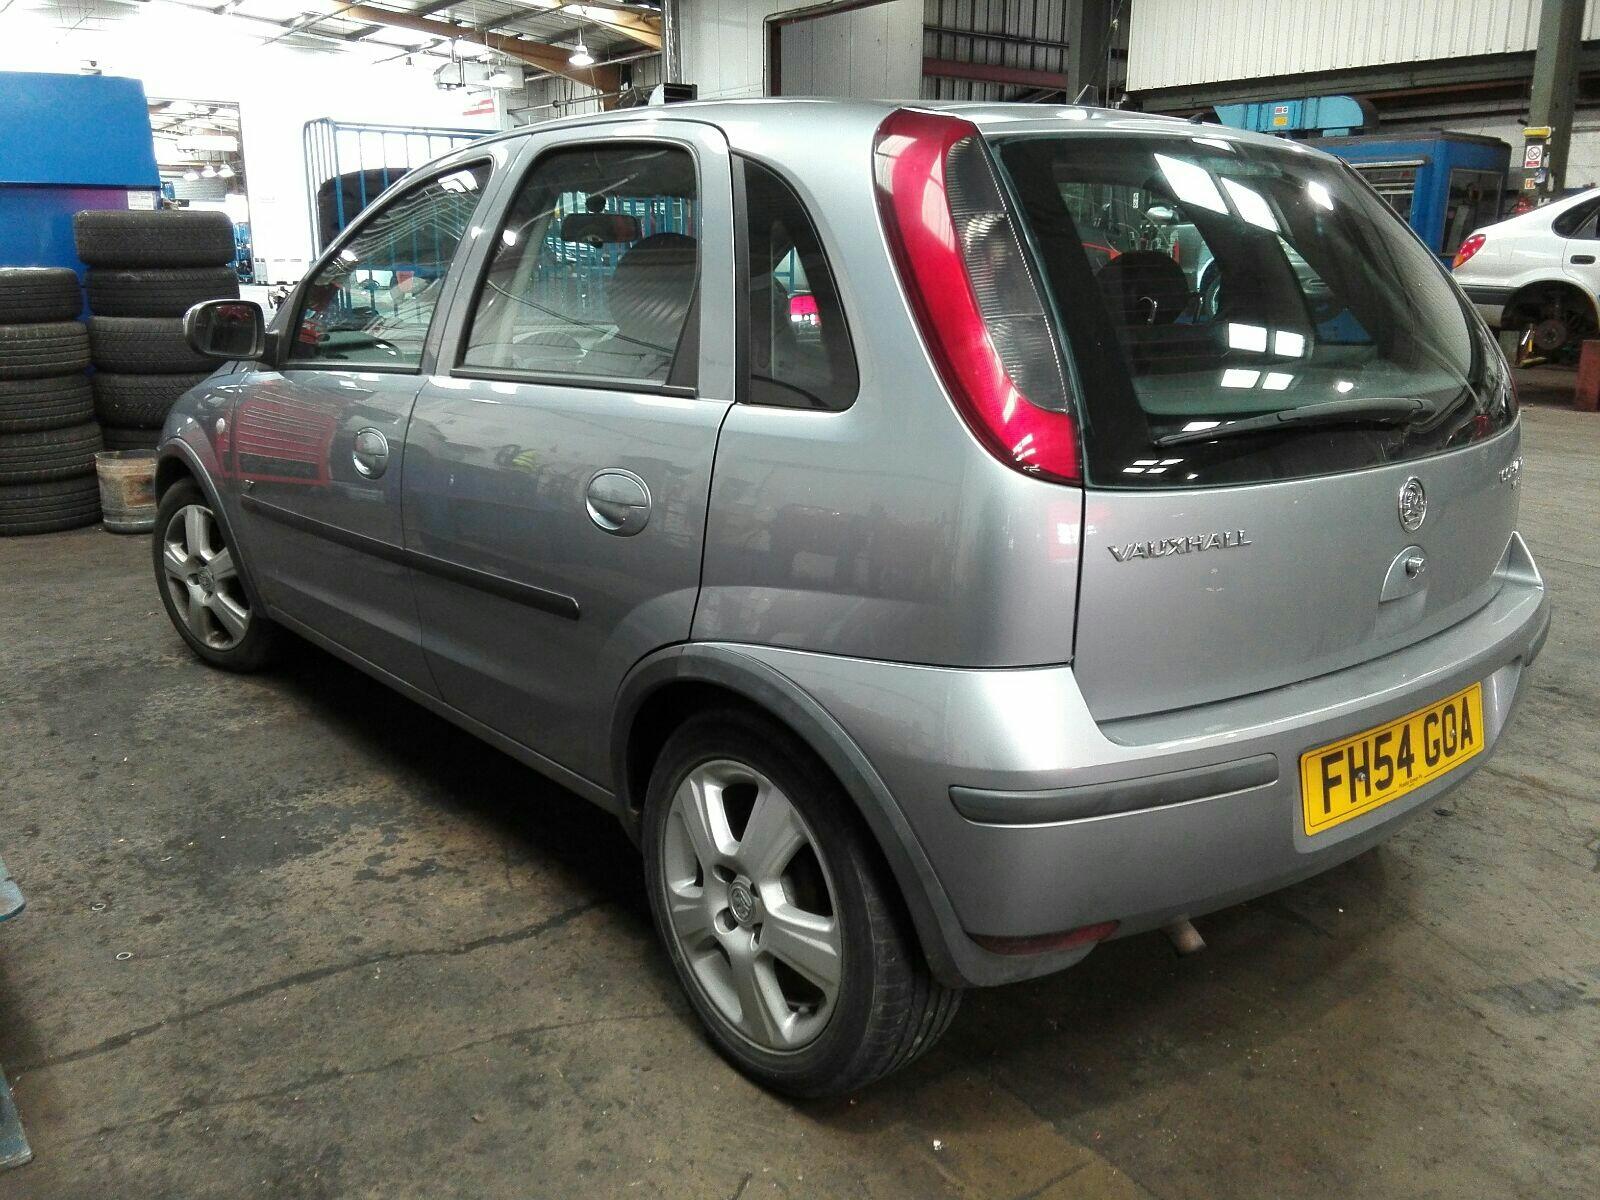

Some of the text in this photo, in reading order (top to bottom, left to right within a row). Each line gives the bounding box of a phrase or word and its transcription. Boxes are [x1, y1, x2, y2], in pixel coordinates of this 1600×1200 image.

[1107, 529, 1252, 562] VAUXHALL
[1321, 696, 1473, 814] FH54 GOA
